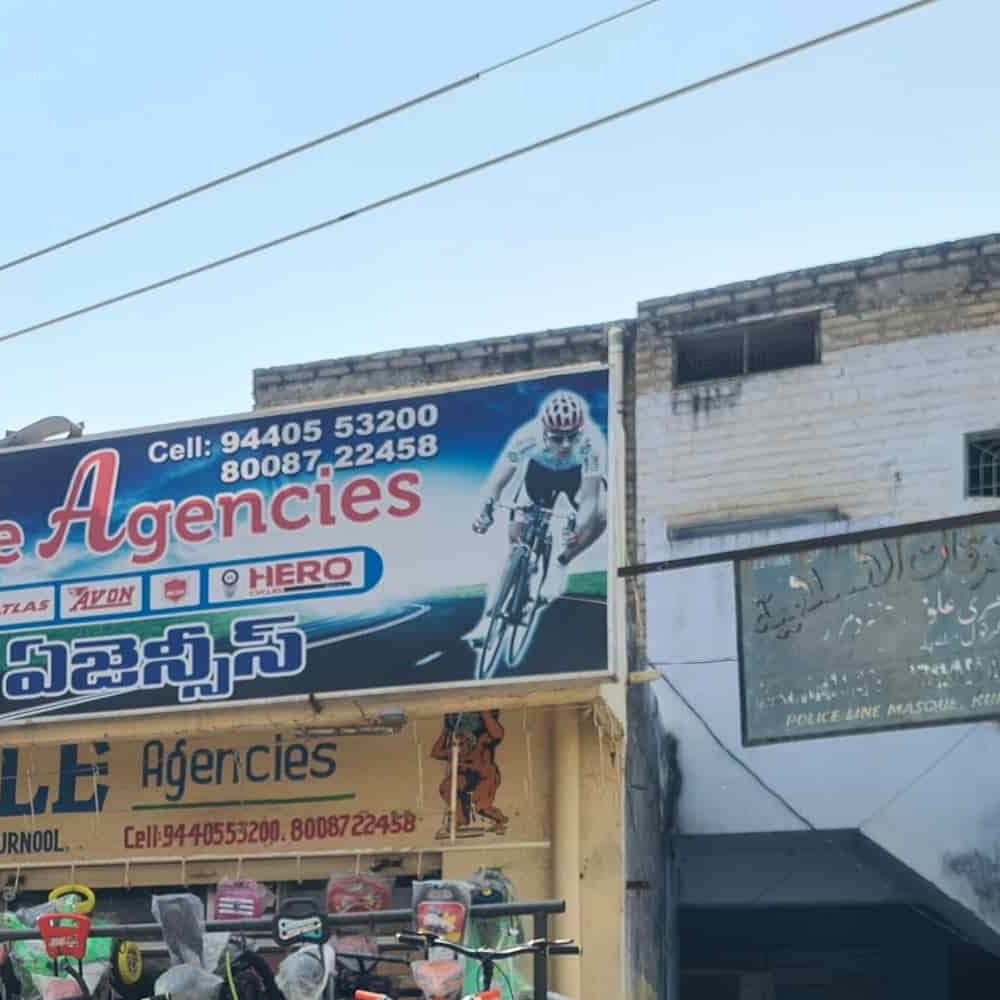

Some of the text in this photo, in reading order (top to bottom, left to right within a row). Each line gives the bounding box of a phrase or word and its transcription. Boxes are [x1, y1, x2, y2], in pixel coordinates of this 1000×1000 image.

[148, 403, 439, 465] Cell: 94405 53200
[220, 434, 439, 483] 80087 22458
[36, 447, 423, 565] Agencies
[248, 556, 353, 589] HERO
[69, 585, 136, 613] AVON
[785, 710, 841, 728] POLICE
[845, 704, 881, 721] LINE
[141, 734, 338, 801] Agencies
